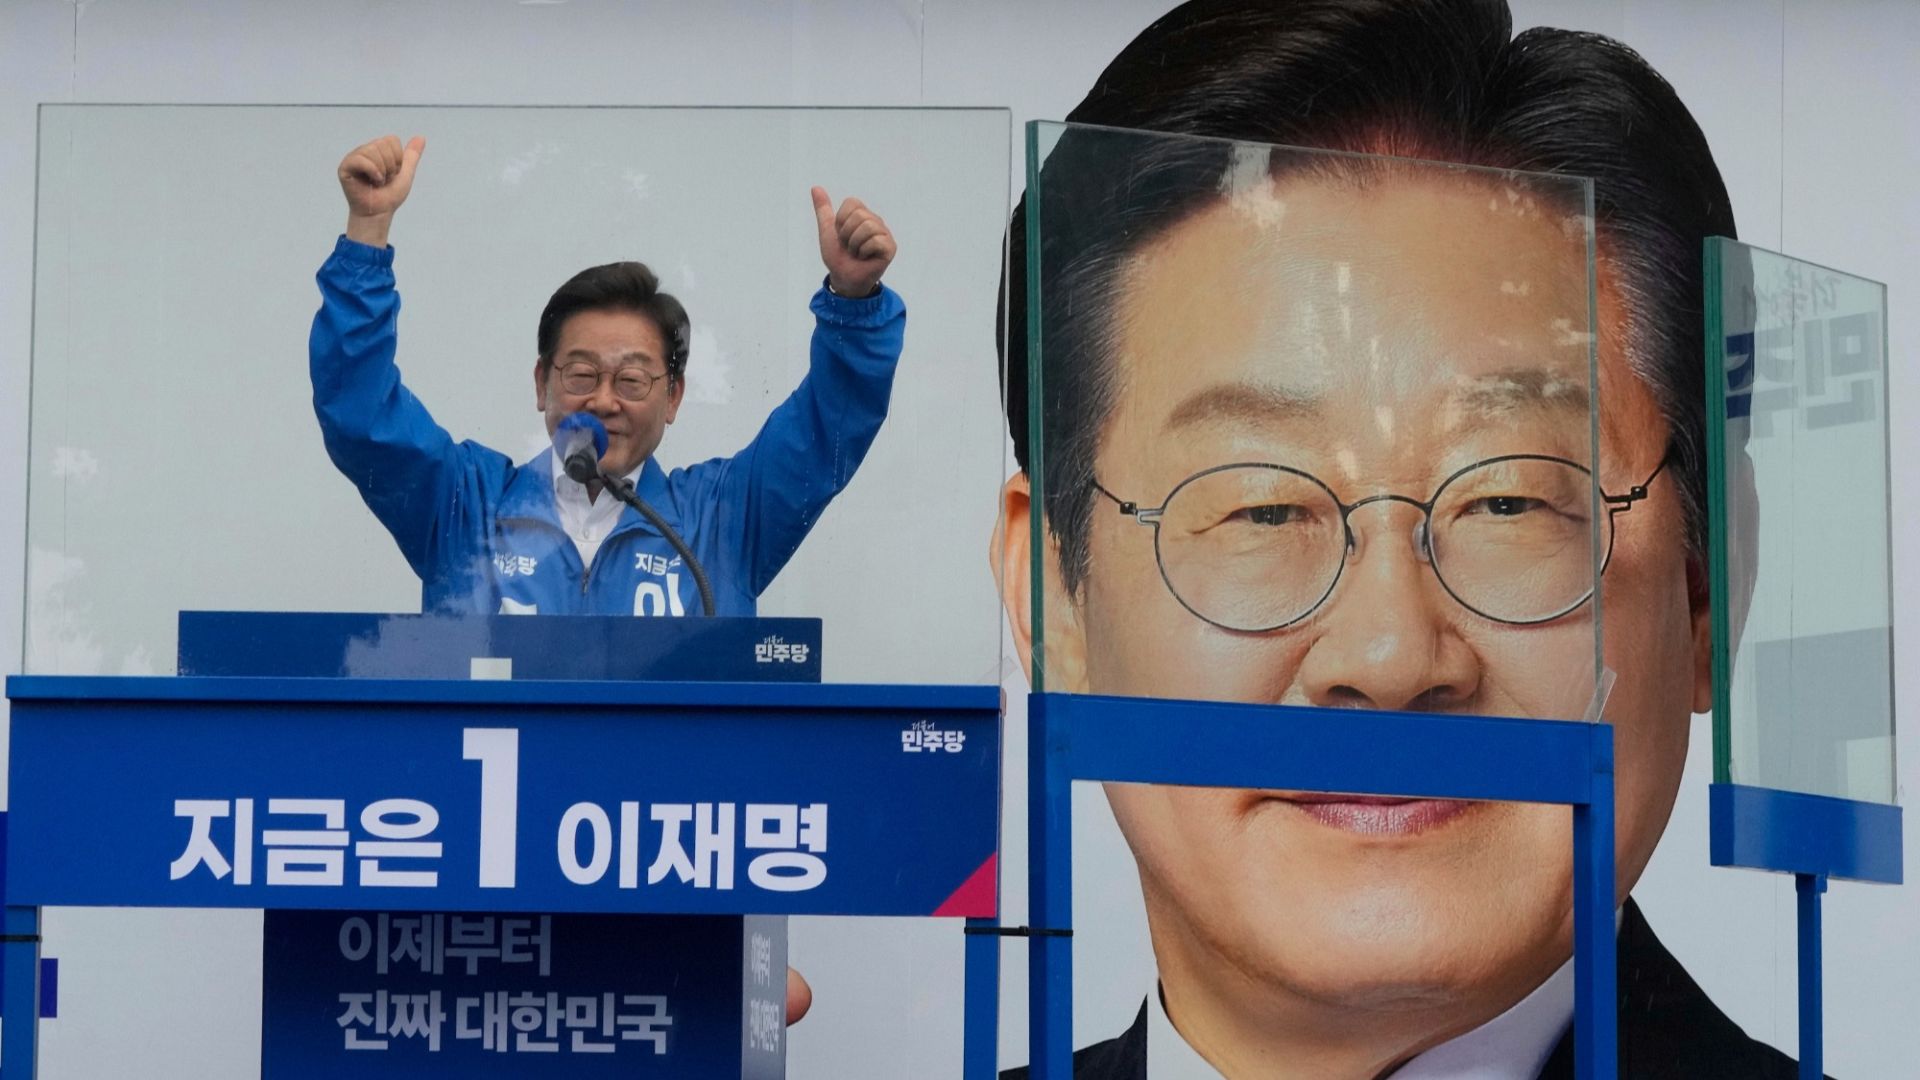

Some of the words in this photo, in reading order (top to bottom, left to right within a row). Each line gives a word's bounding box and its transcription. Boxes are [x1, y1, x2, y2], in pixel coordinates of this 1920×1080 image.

[755, 643, 810, 663] 민주당
[901, 730, 966, 753] 민주당
[169, 797, 443, 888] 지금은
[462, 727, 519, 889] 1
[556, 800, 829, 892] 이재명
[337, 912, 552, 977] 이제부터
[335, 989, 447, 1052] 진짜
[455, 990, 674, 1055] 대한민국
